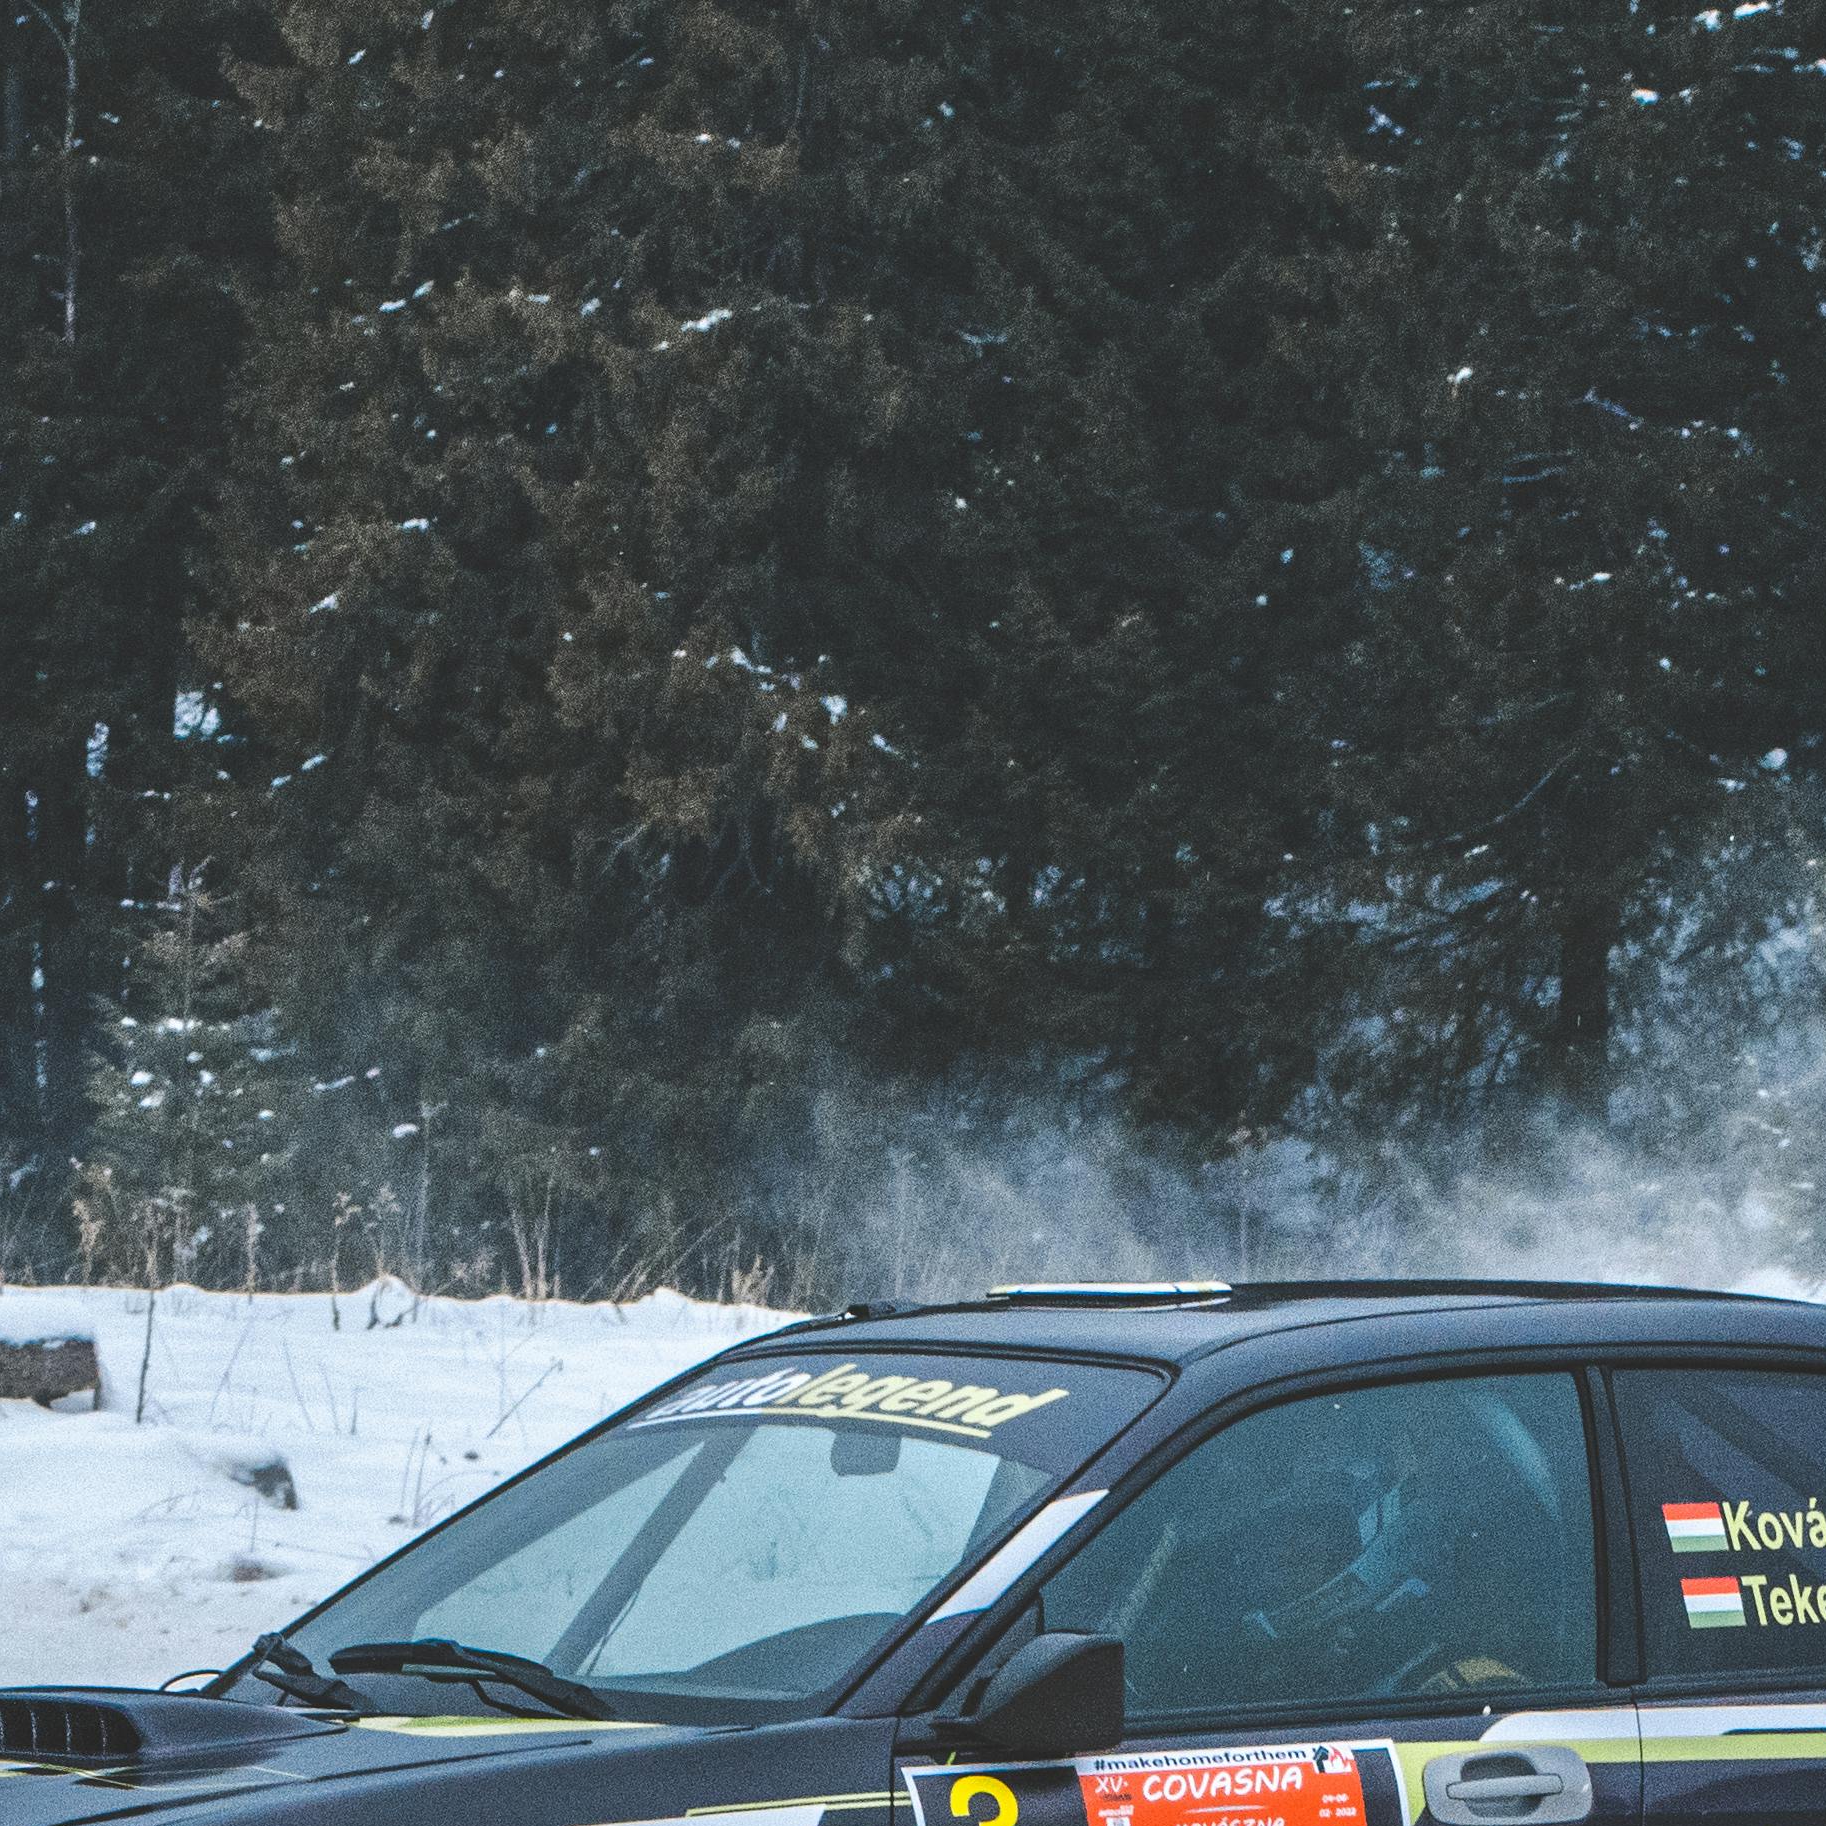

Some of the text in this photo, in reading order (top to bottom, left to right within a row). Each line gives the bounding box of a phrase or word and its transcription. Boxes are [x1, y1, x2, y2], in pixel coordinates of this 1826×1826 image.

[643, 1363, 1070, 1430] autolegend
[1093, 1749, 1307, 1772] #makehomeforthem
[1142, 1765, 1303, 1802] COVASNA
